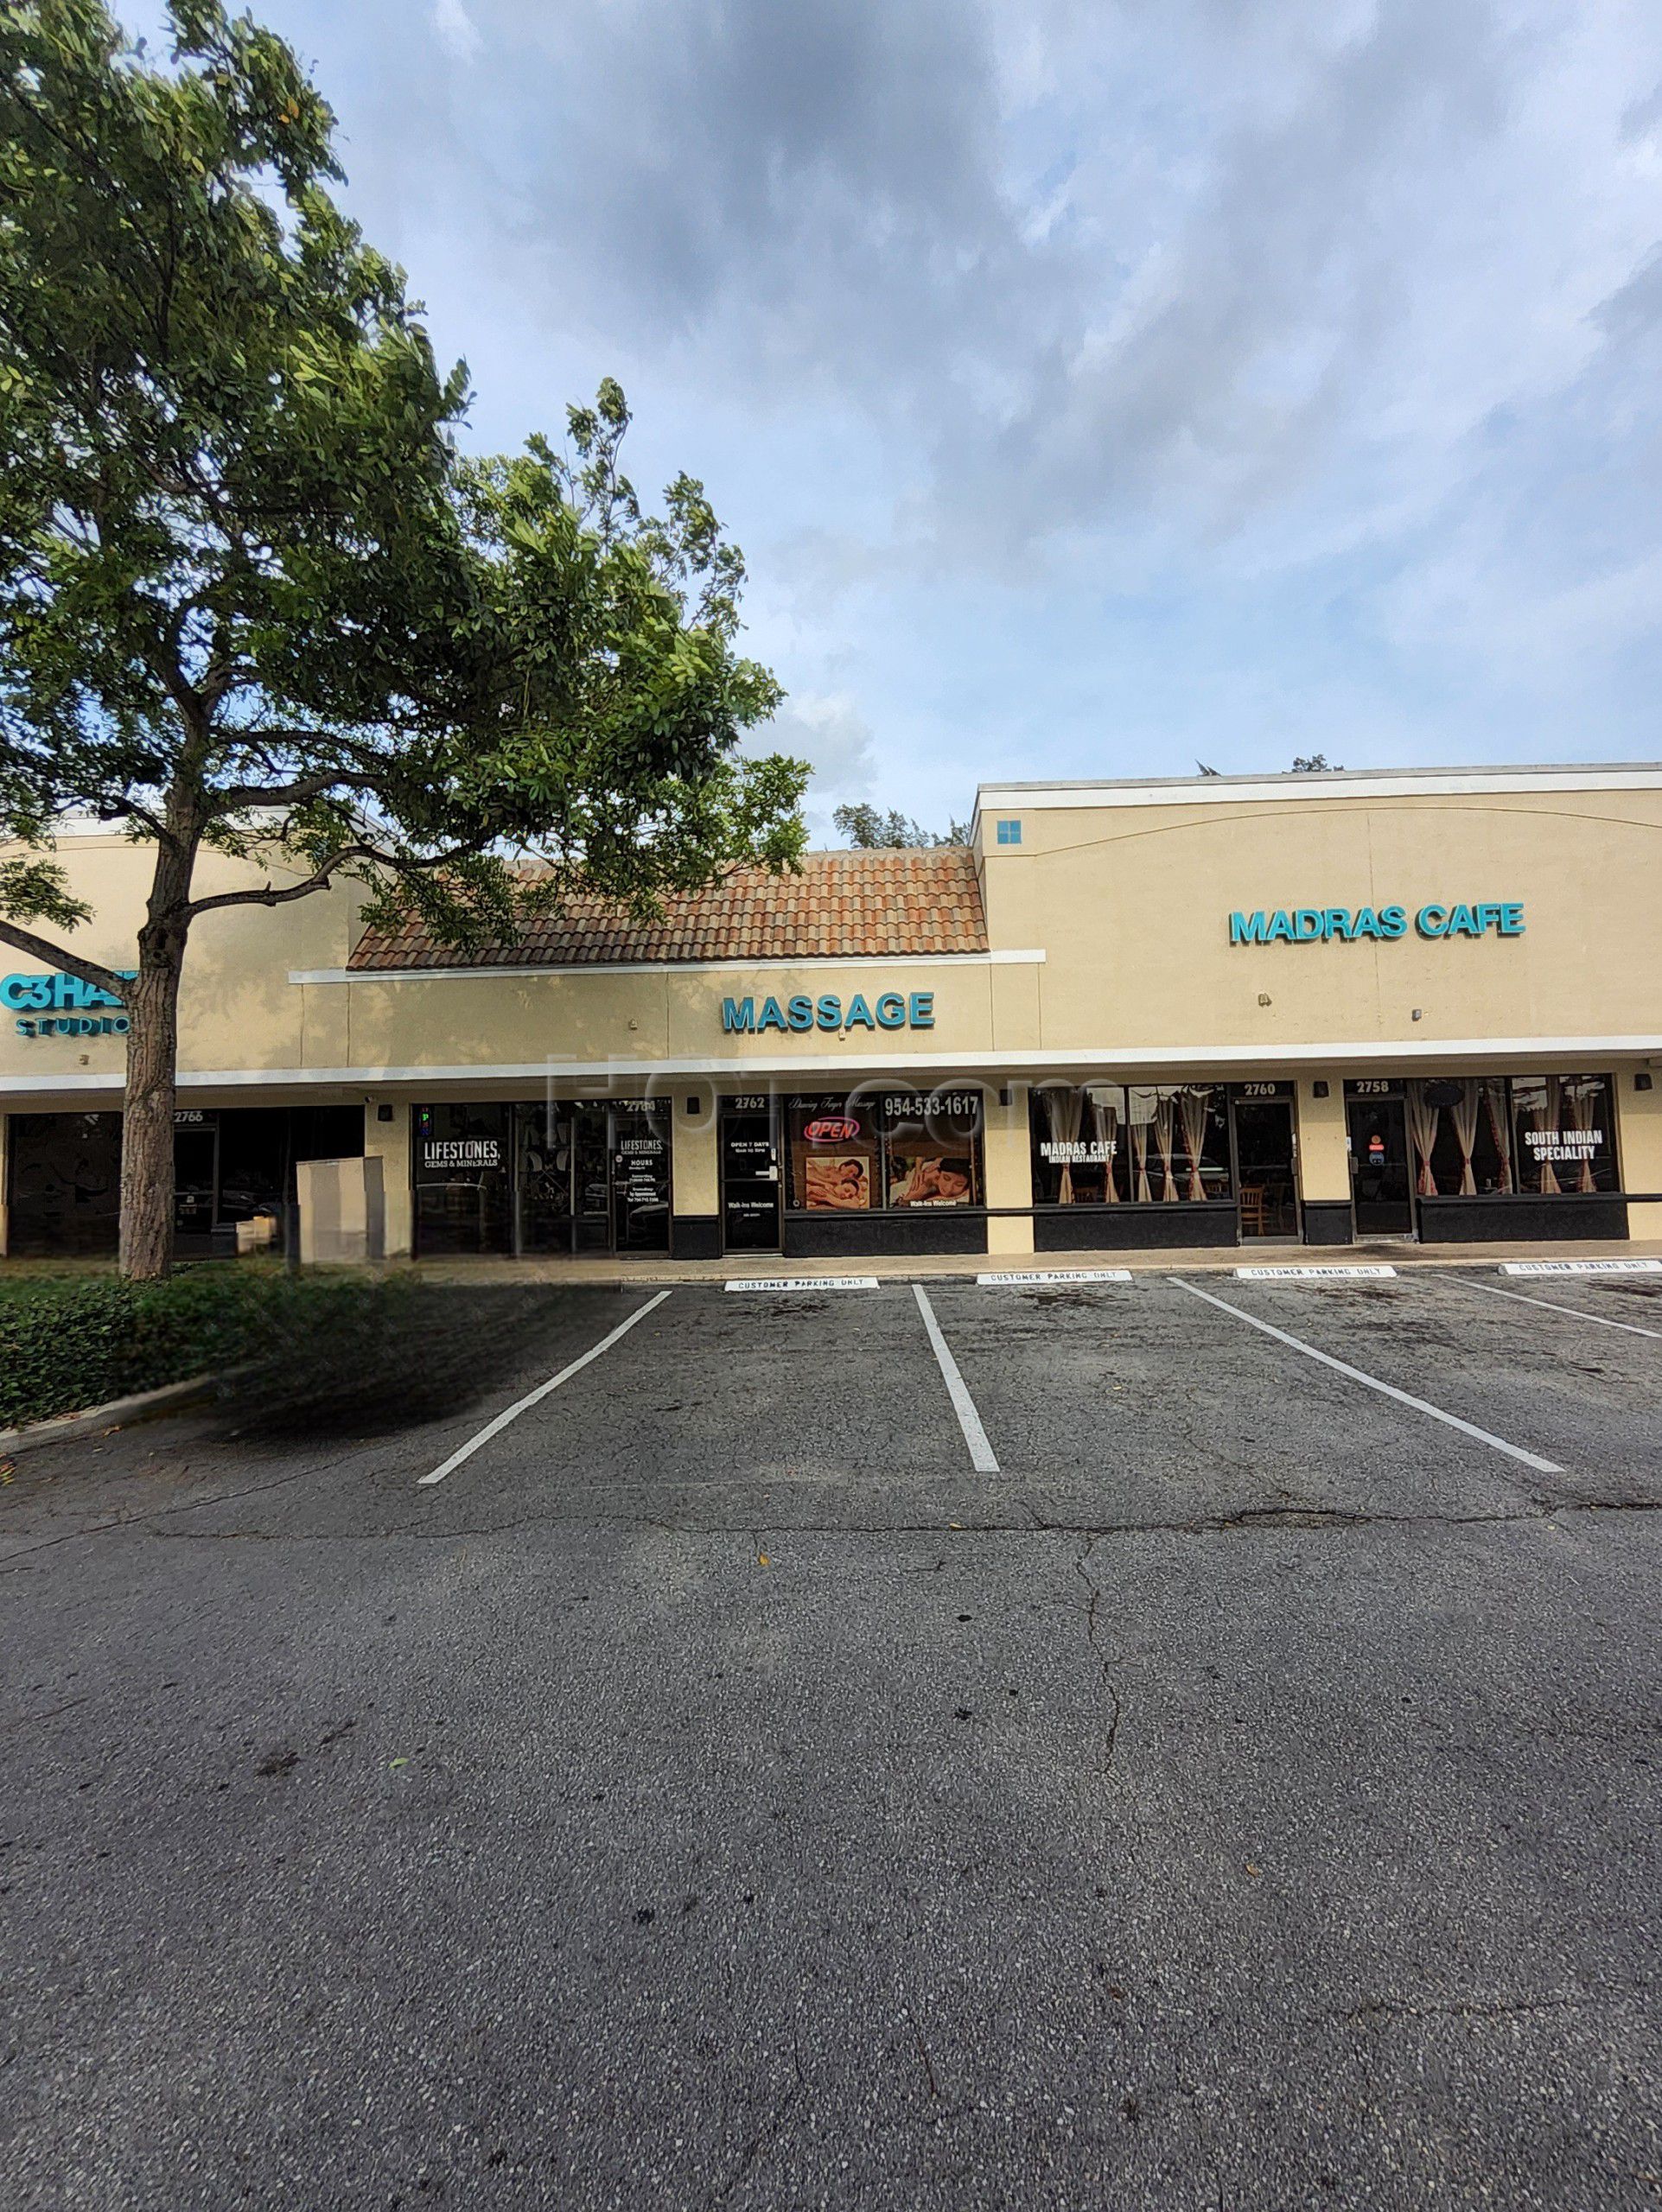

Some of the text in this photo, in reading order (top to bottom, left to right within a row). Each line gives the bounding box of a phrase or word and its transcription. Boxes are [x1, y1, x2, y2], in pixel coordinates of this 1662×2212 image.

[1230, 903, 1526, 944] MADRAS CAFE
[723, 992, 935, 1032] MASSAGE
[16, 1015, 131, 1035] STUDIO
[1245, 1083, 1276, 1096] 2760
[1356, 1081, 1389, 1093] 2758
[735, 1096, 765, 1109] 2762
[885, 1096, 978, 1116] 954-533-1617
[174, 1110, 203, 1122] 2766
[808, 1121, 855, 1139] OPEN
[1525, 1129, 1602, 1146] SOUTH INDIAN
[1040, 1141, 1118, 1157] MADRAS CAFE
[1533, 1146, 1595, 1161] SPECIALITY
[456, 1159, 498, 1167] MINERALS
[1072, 1154, 1110, 1163] RESTAURANT
[1309, 1268, 1351, 1276] PARKING
[1519, 1261, 1648, 1271] CUSTOMER PARKING ONLY
